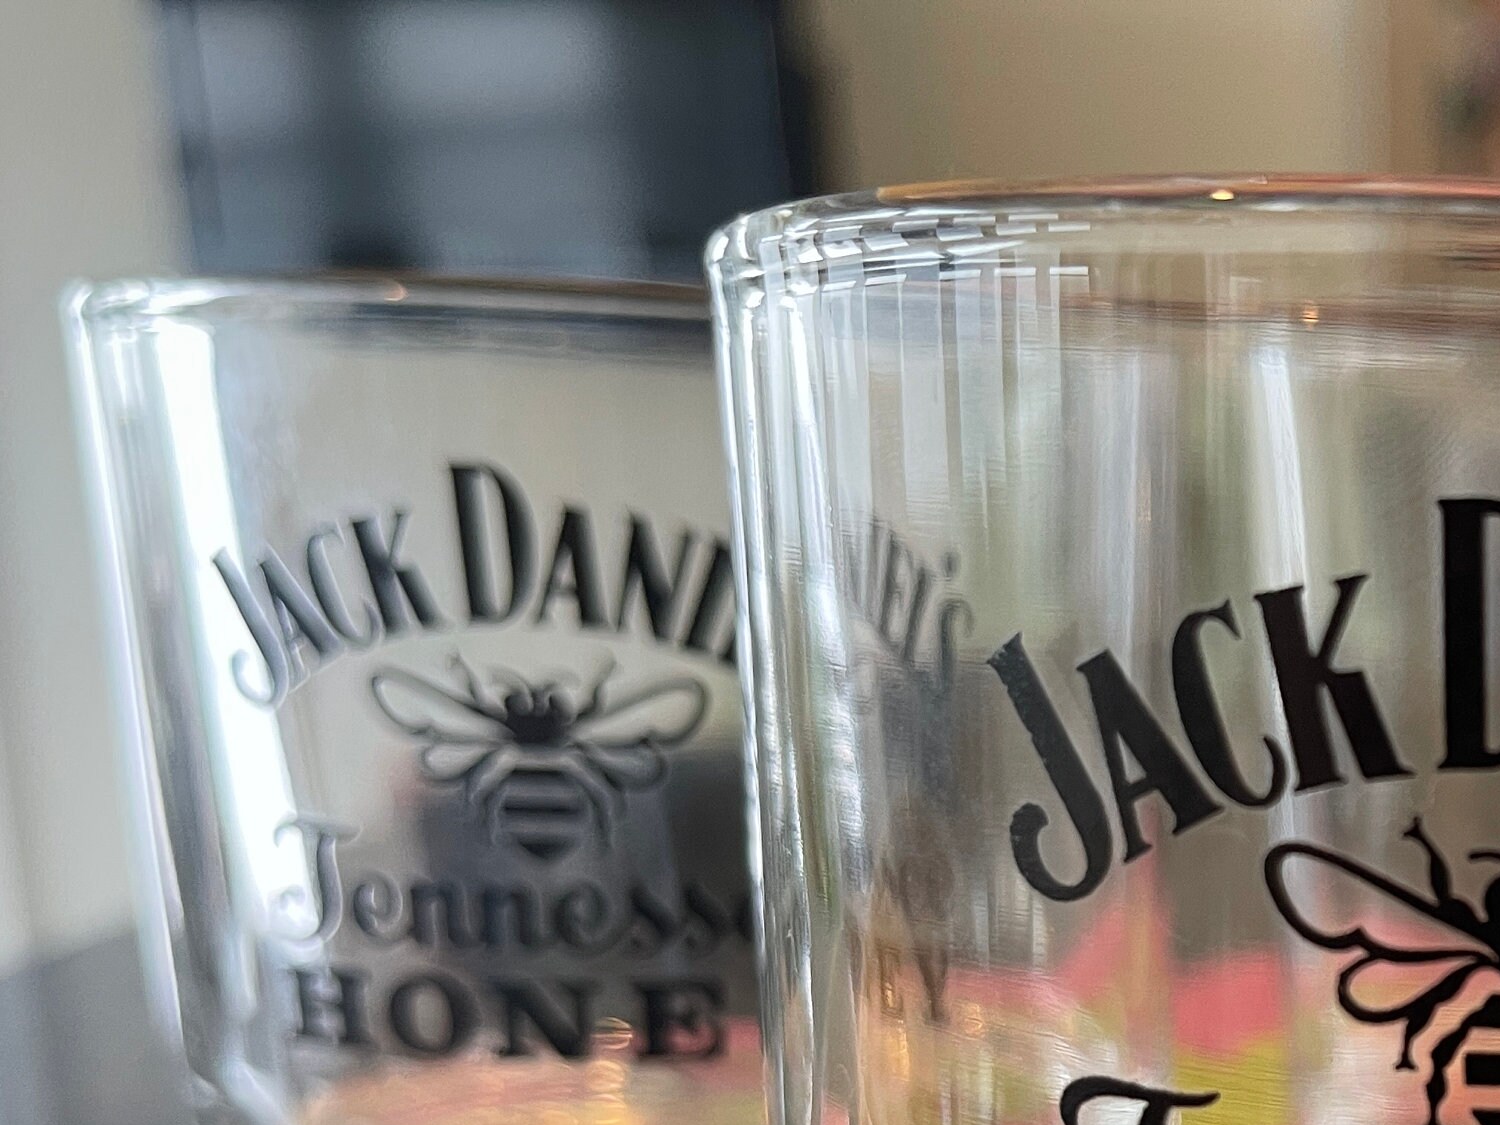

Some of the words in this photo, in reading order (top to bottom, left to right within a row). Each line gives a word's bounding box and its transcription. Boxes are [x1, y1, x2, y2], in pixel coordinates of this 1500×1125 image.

[211, 507, 443, 710] JACK
[448, 459, 742, 668] DANI
[987, 573, 1415, 902] JACK
[266, 812, 760, 960] Tenness
